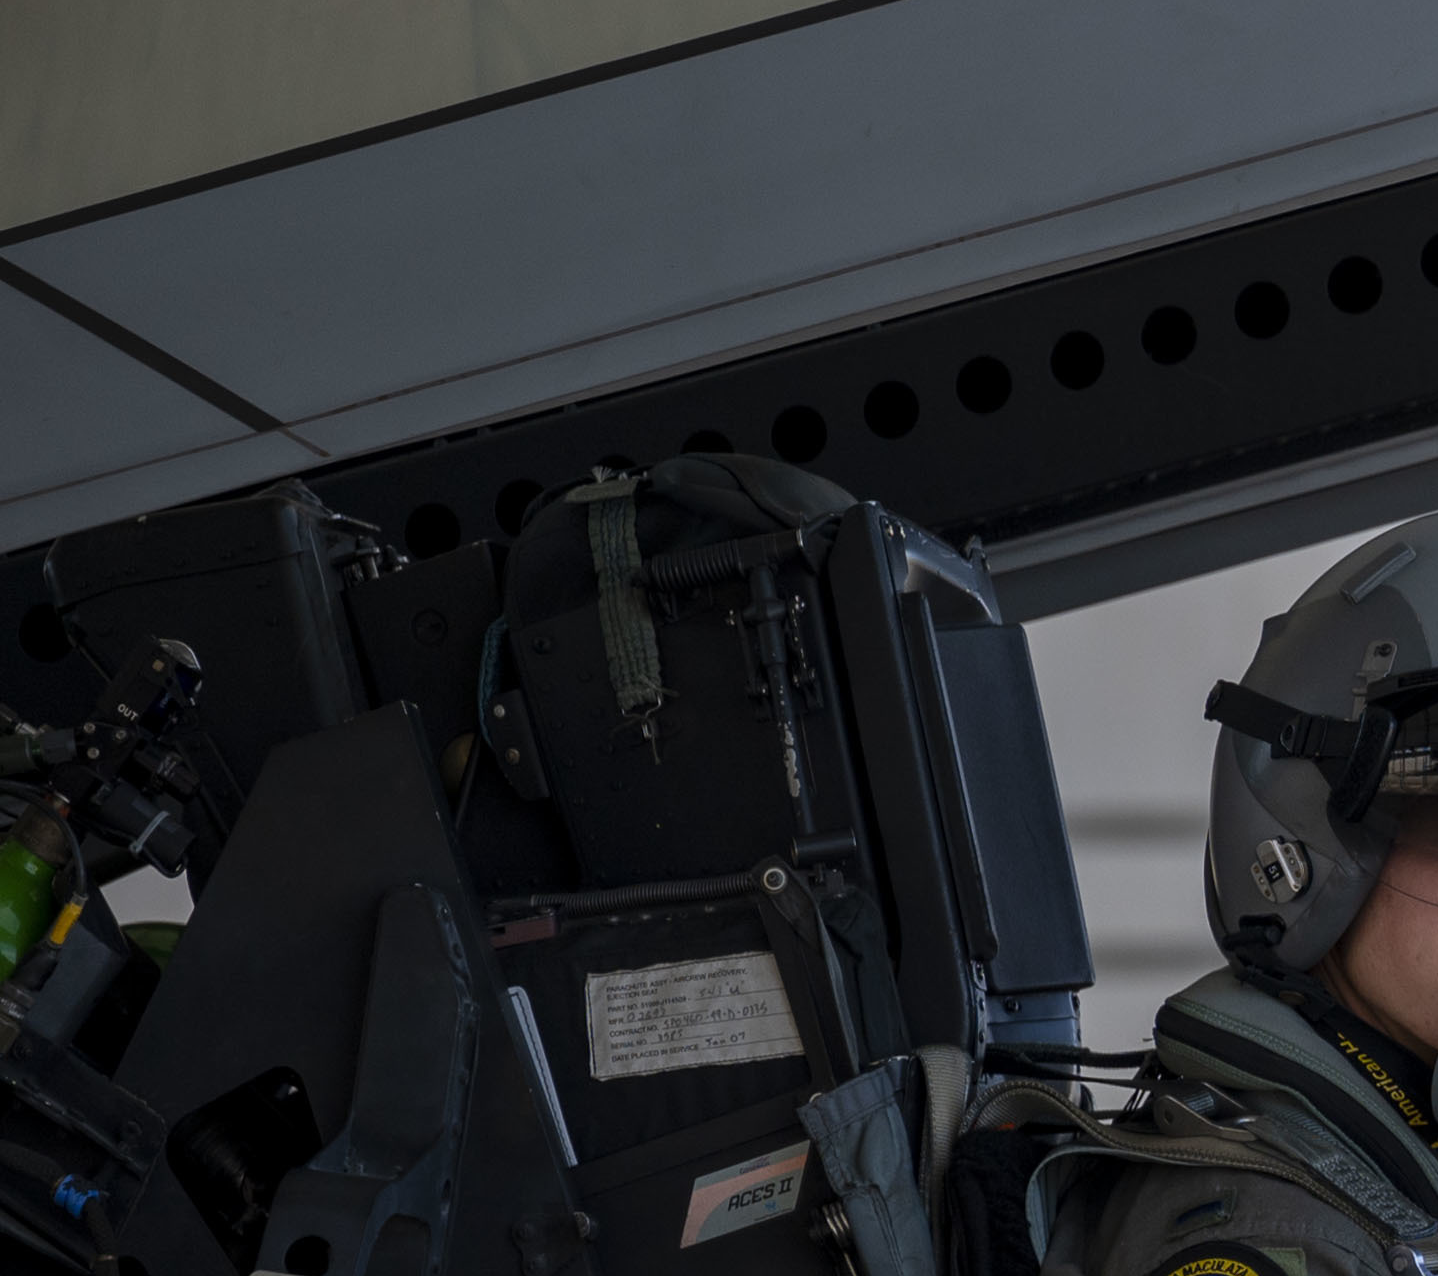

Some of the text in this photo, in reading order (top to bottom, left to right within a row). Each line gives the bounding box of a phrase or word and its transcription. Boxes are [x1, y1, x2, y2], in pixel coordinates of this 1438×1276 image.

[117, 703, 138, 721] OUT
[606, 982, 647, 993] PARACHUTE
[674, 973, 706, 983] AIRCREW
[607, 988, 658, 1001] EJECTION SEAT
[608, 1004, 625, 1013] PART
[609, 1026, 646, 1038] CONTRACT
[611, 1052, 630, 1063] DATE
[631, 1049, 660, 1061] PLACED
[669, 1044, 699, 1055] SERVICE
[1358, 1053, 1429, 1126] American
[727, 1176, 794, 1212] ACES II
